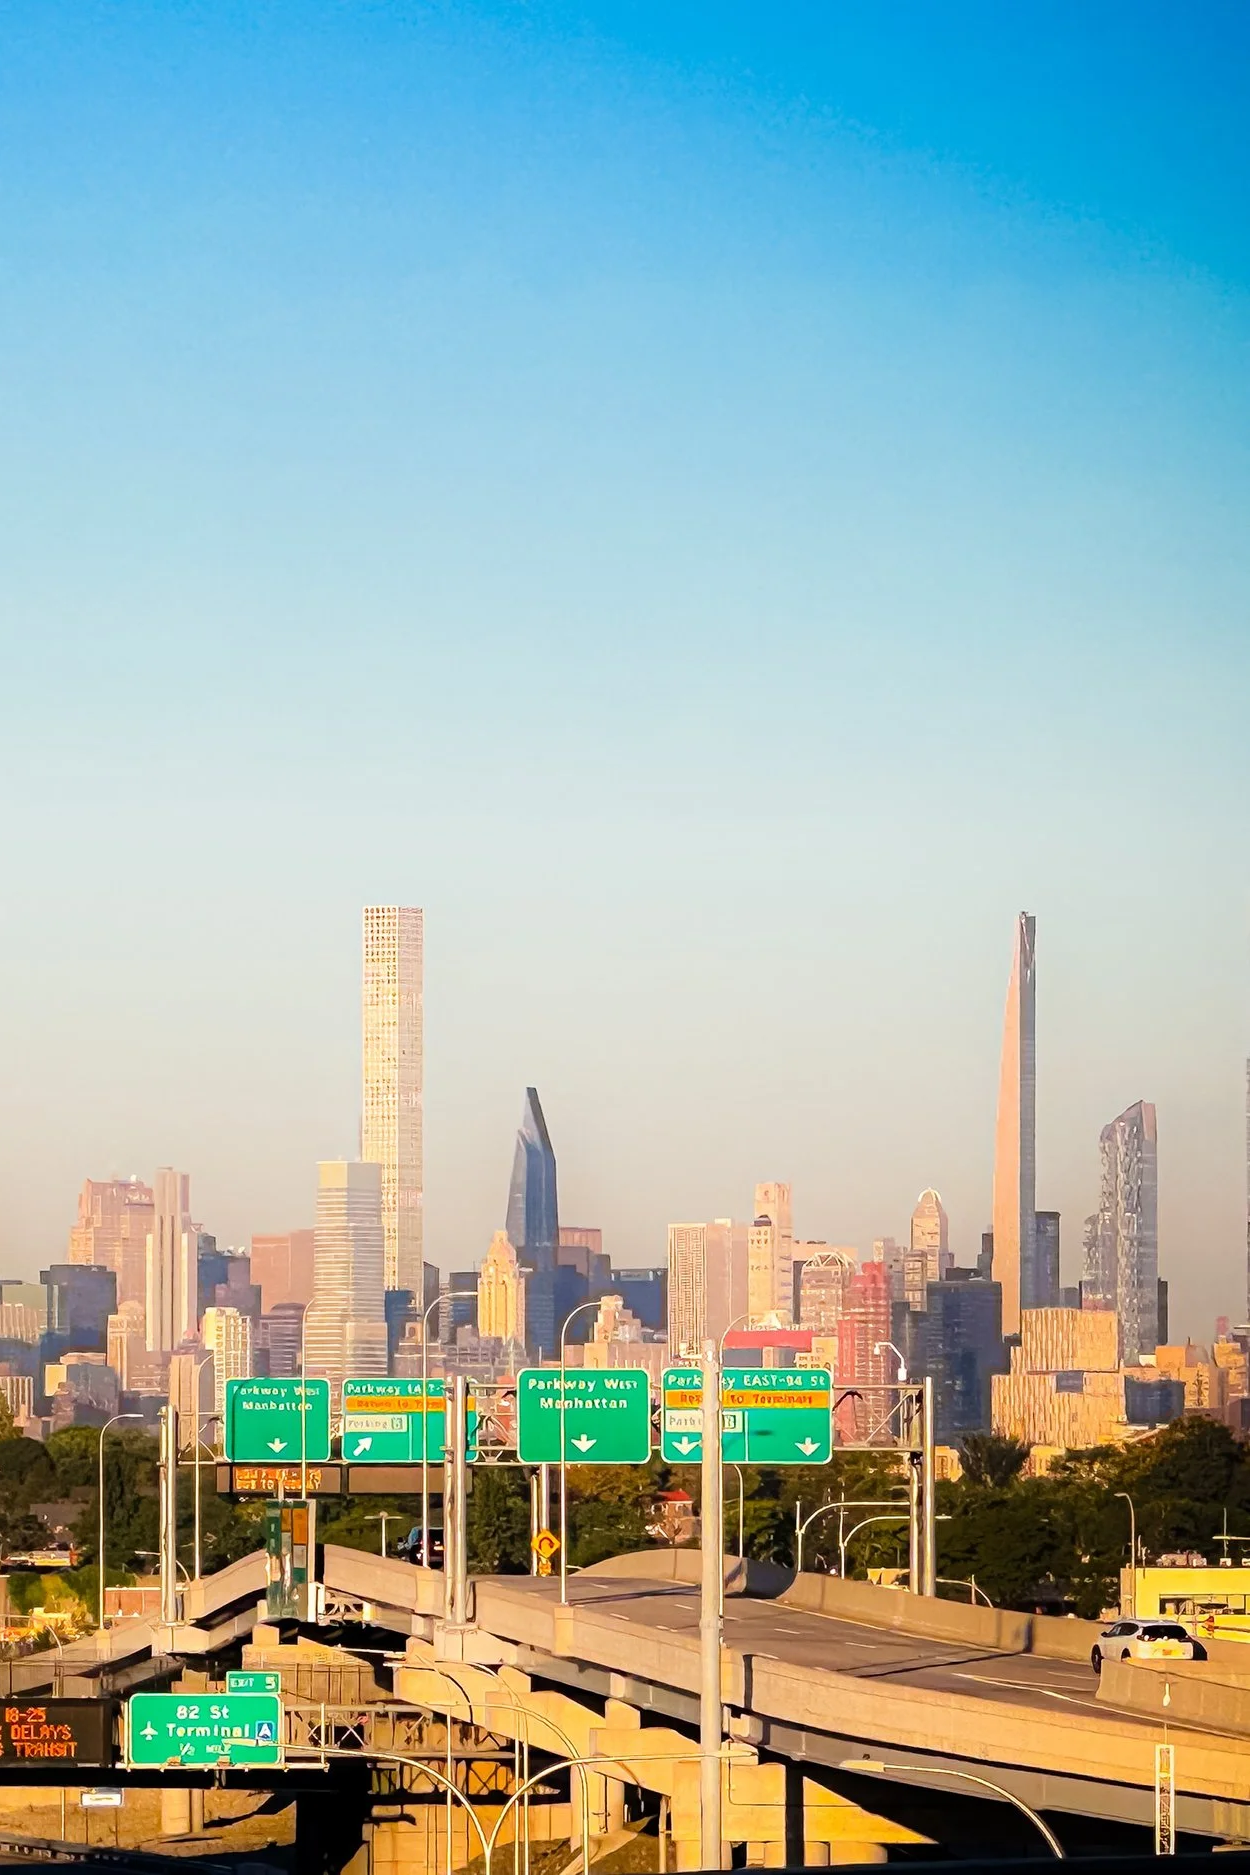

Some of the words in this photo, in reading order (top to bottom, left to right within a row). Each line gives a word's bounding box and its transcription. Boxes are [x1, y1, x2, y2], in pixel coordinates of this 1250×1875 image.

[528, 1378, 596, 1392] Parkway
[604, 1378, 638, 1390] West
[810, 1375, 825, 1386] St
[347, 1383, 400, 1395] Parkway
[242, 1401, 313, 1411] Manhattan
[540, 1398, 627, 1409] Manhattan
[230, 1677, 254, 1688] EXIT
[5, 1707, 47, 1723] 18-25
[176, 1705, 200, 1720] 82
[209, 1704, 230, 1720] St
[11, 1724, 72, 1740] DELAYS
[166, 1723, 250, 1738] Terminal
[258, 1722, 273, 1740] A
[12, 1741, 78, 1758] TRANSIT
